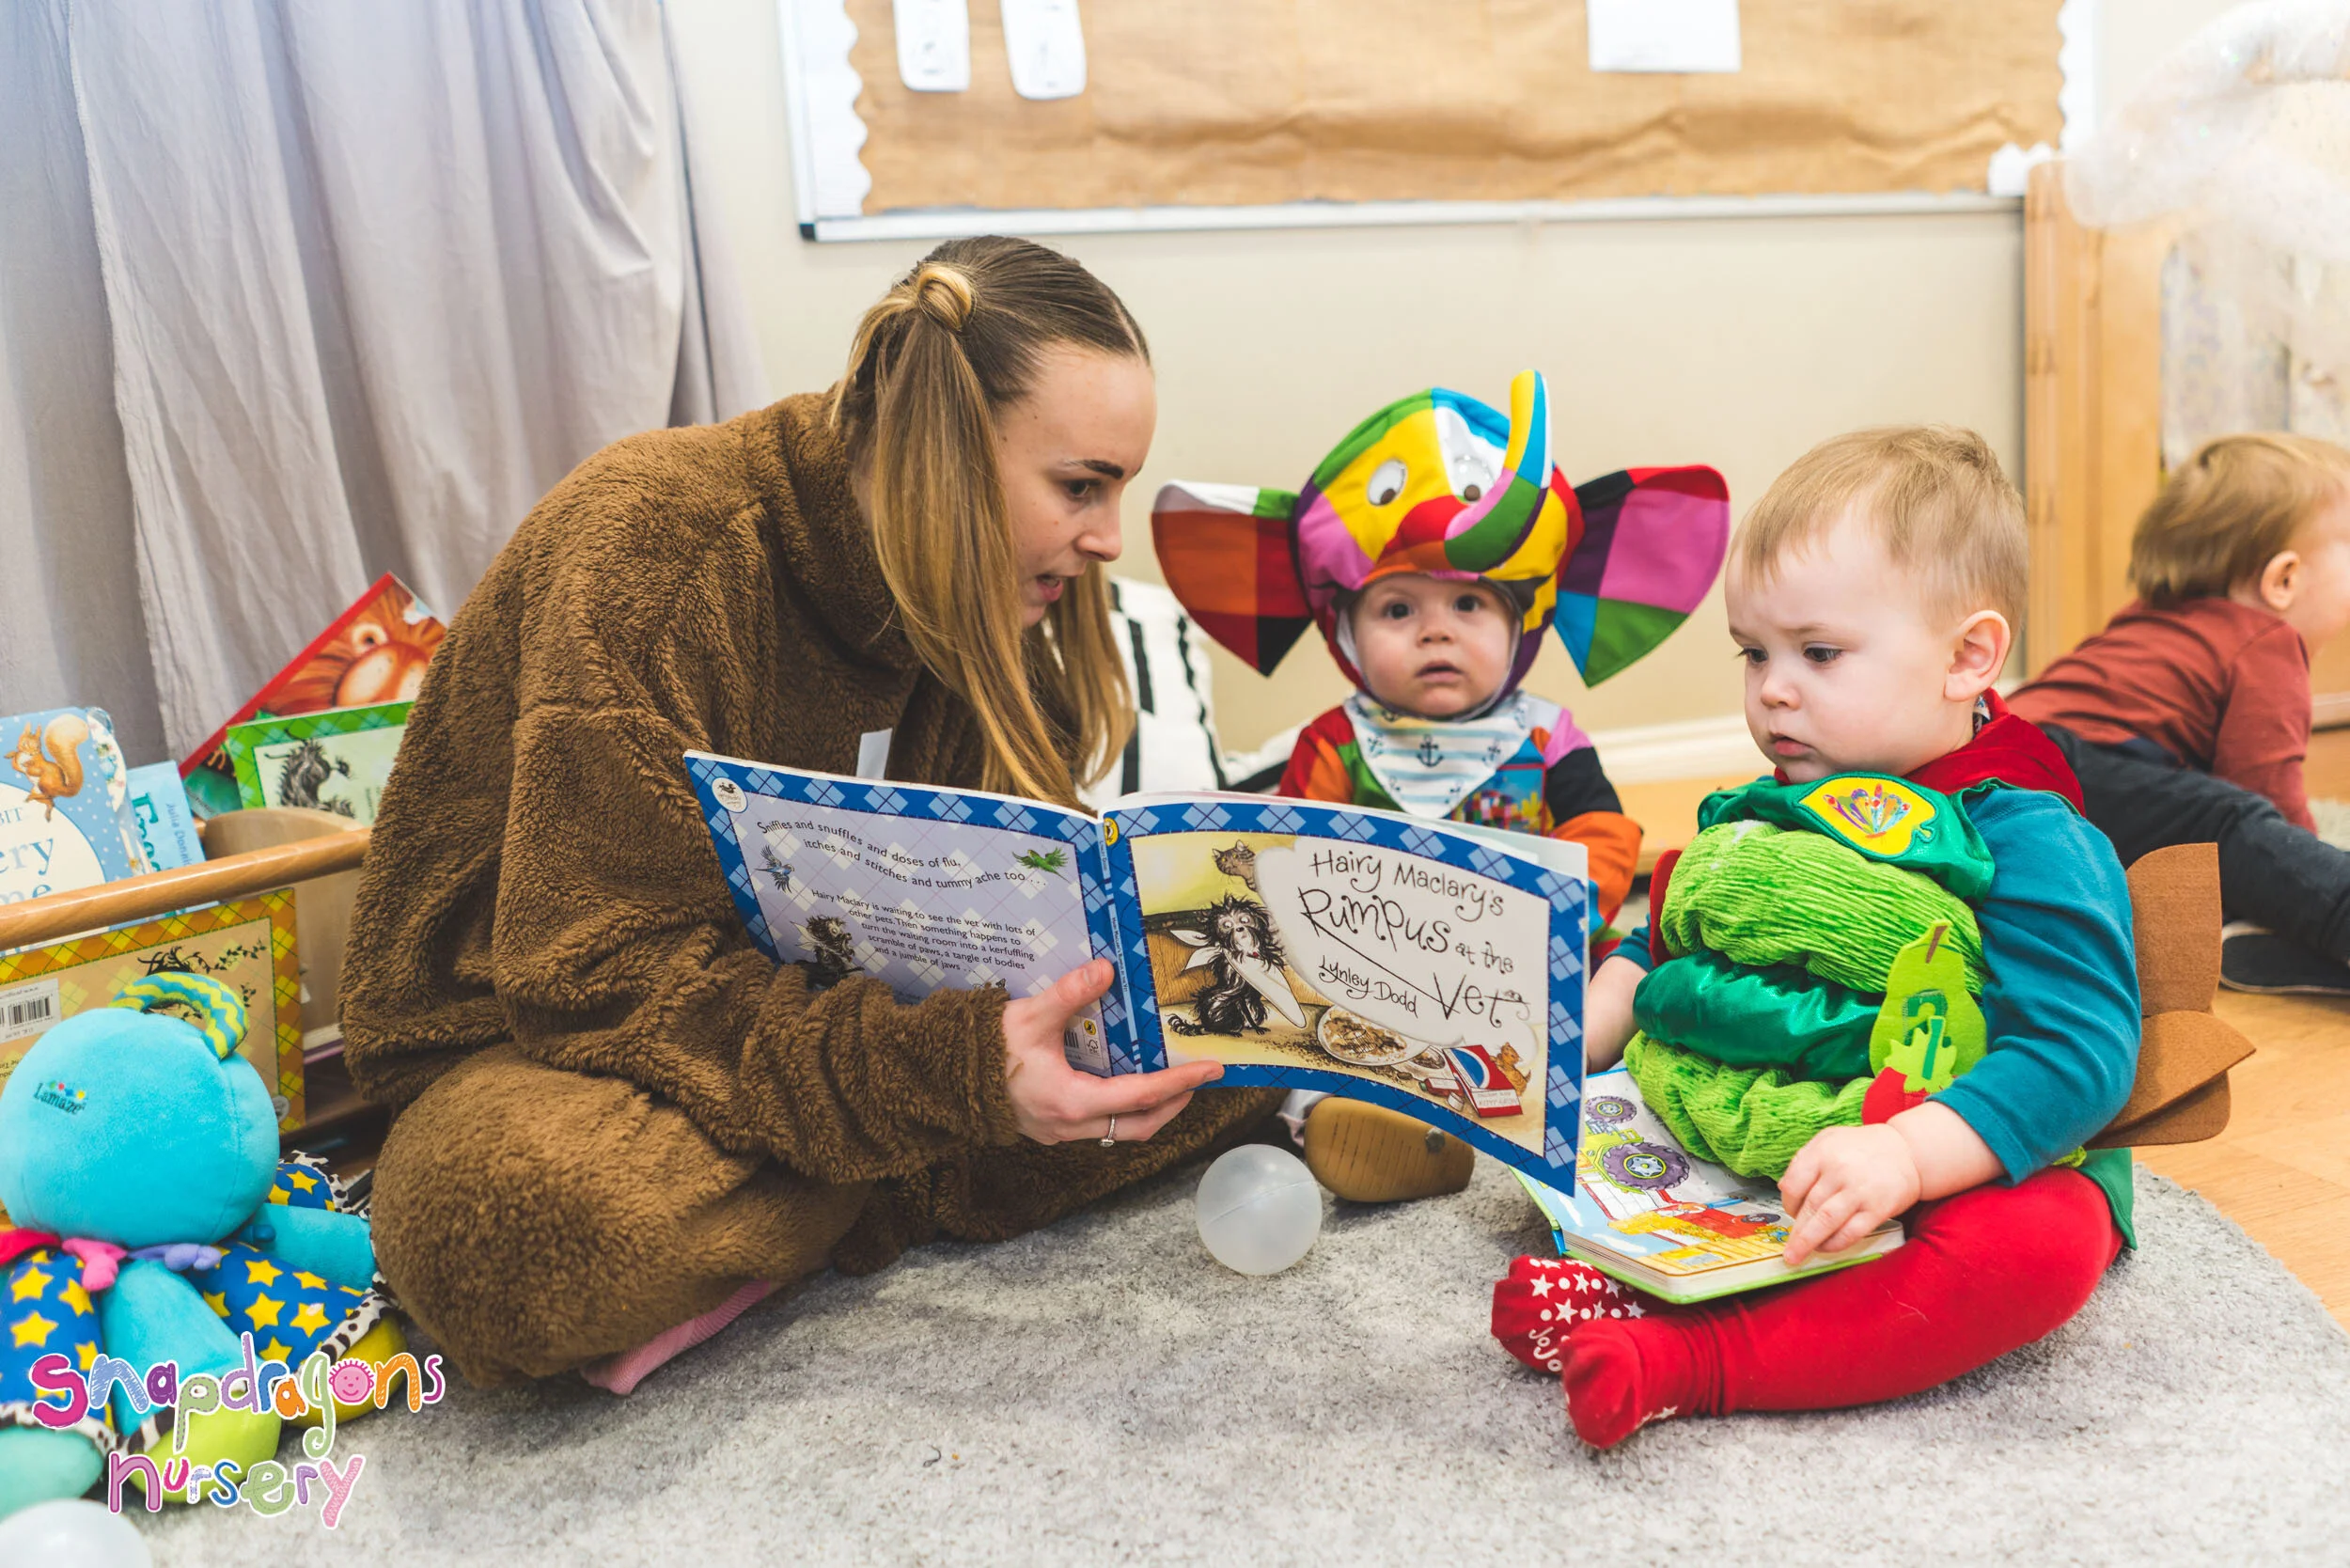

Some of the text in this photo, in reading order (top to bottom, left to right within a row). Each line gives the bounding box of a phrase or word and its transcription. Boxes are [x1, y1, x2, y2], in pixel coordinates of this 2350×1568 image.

[757, 820, 792, 834] Sniffles
[795, 821, 814, 830] and
[818, 823, 863, 845] snuffles
[867, 842, 887, 857] and
[891, 853, 925, 867] doses
[928, 857, 940, 868] of
[804, 839, 837, 853] itches
[839, 848, 861, 861] and
[864, 858, 908, 883] stitches
[911, 877, 932, 887] and
[935, 879, 973, 889] tummy
[975, 870, 1001, 885] ache
[1004, 871, 1026, 881] too
[1309, 849, 1505, 922] Hairy Maclary's
[811, 889, 835, 902] Hairy
[837, 895, 870, 910] Maclary
[872, 902, 880, 911] is
[881, 905, 914, 919] waiting
[946, 916, 962, 925] the
[982, 921, 1003, 931] with
[1005, 924, 1023, 934] lots
[1026, 928, 1036, 936] of
[849, 910, 871, 919] other
[920, 924, 968, 939] something
[969, 930, 1008, 944] happens
[1010, 937, 1021, 946] to
[1297, 886, 1514, 974] Rumpus at the
[861, 922, 880, 932] turn
[882, 926, 897, 935] the
[899, 931, 930, 945] waiting
[932, 937, 957, 948] room
[960, 941, 978, 950] into
[989, 945, 1035, 962] kerfuffling
[868, 934, 905, 949] scramble
[952, 951, 979, 963] tangle
[982, 956, 993, 964] of
[995, 957, 1026, 969] bodies
[873, 946, 889, 955] and
[899, 950, 928, 964] jumble
[930, 958, 939, 966] of
[941, 960, 961, 970] jaws
[1318, 955, 1418, 1019] Lynley Dodd
[1433, 972, 1531, 1028] Vet
